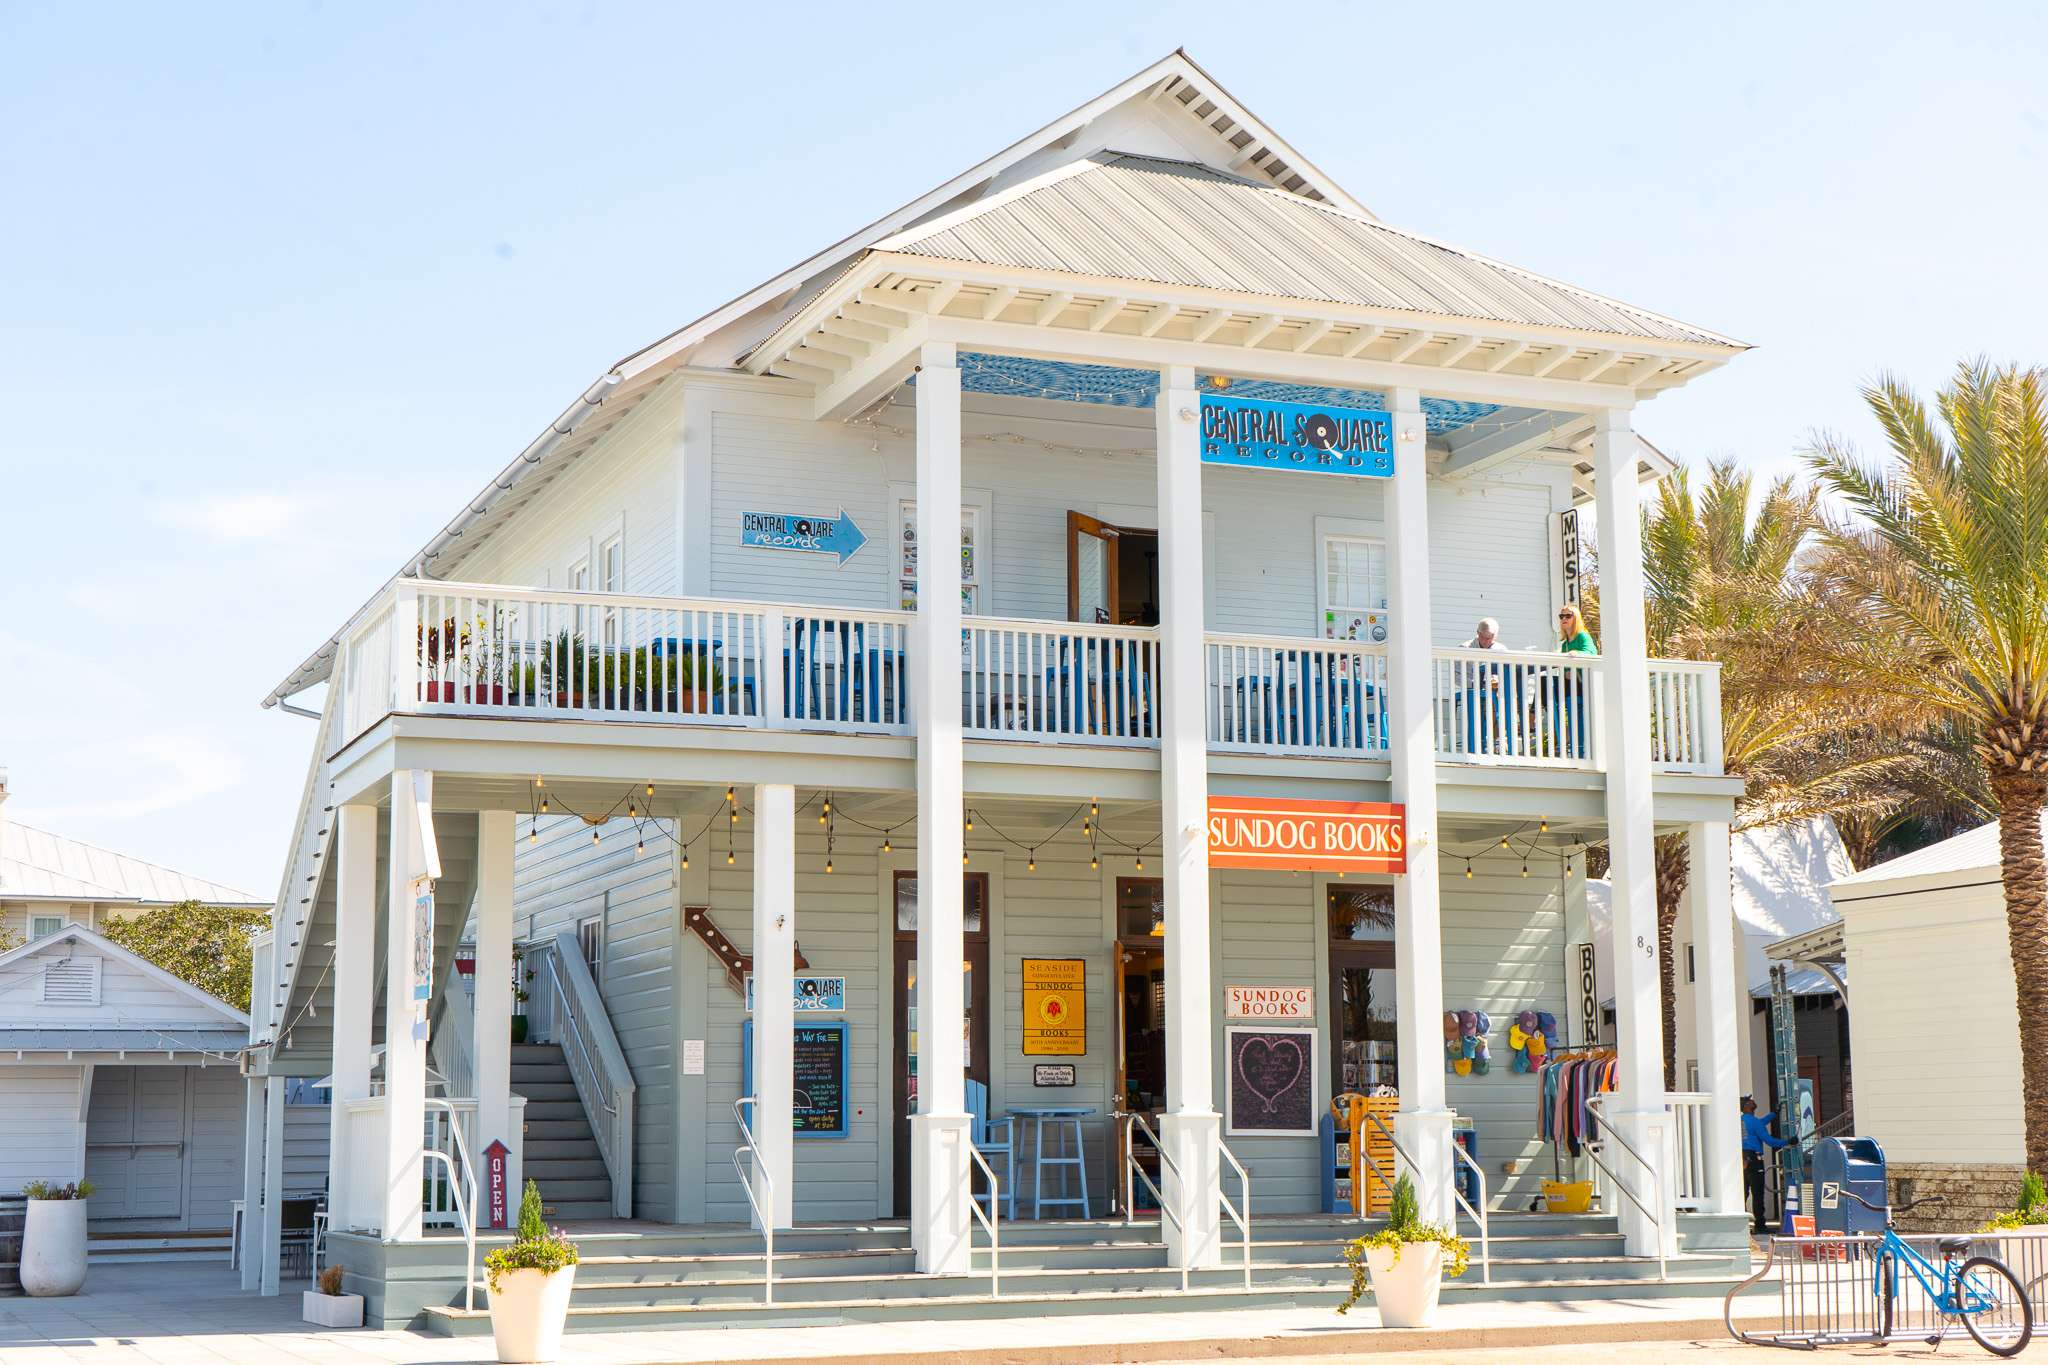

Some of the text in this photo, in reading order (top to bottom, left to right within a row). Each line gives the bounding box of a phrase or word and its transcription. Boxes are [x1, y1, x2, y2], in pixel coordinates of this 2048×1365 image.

[1202, 404, 1389, 454] CENTRAL SQUARE
[1206, 443, 1388, 469] RECORDS
[744, 514, 834, 538] CENTRAL SQUARE
[754, 531, 821, 549] records
[1563, 514, 1577, 603] MUSI
[1209, 816, 1402, 853] SUNDOG BOOKS
[1637, 935, 1654, 958] 89
[798, 979, 841, 997] SQUARE
[1233, 990, 1307, 1002] SUNDOG
[1581, 946, 1596, 1049] BOOK
[793, 995, 829, 1009] ords
[1242, 1003, 1298, 1015] BOOKS
[802, 1031, 815, 1041] WAY
[492, 1158, 503, 1222] OPEN
